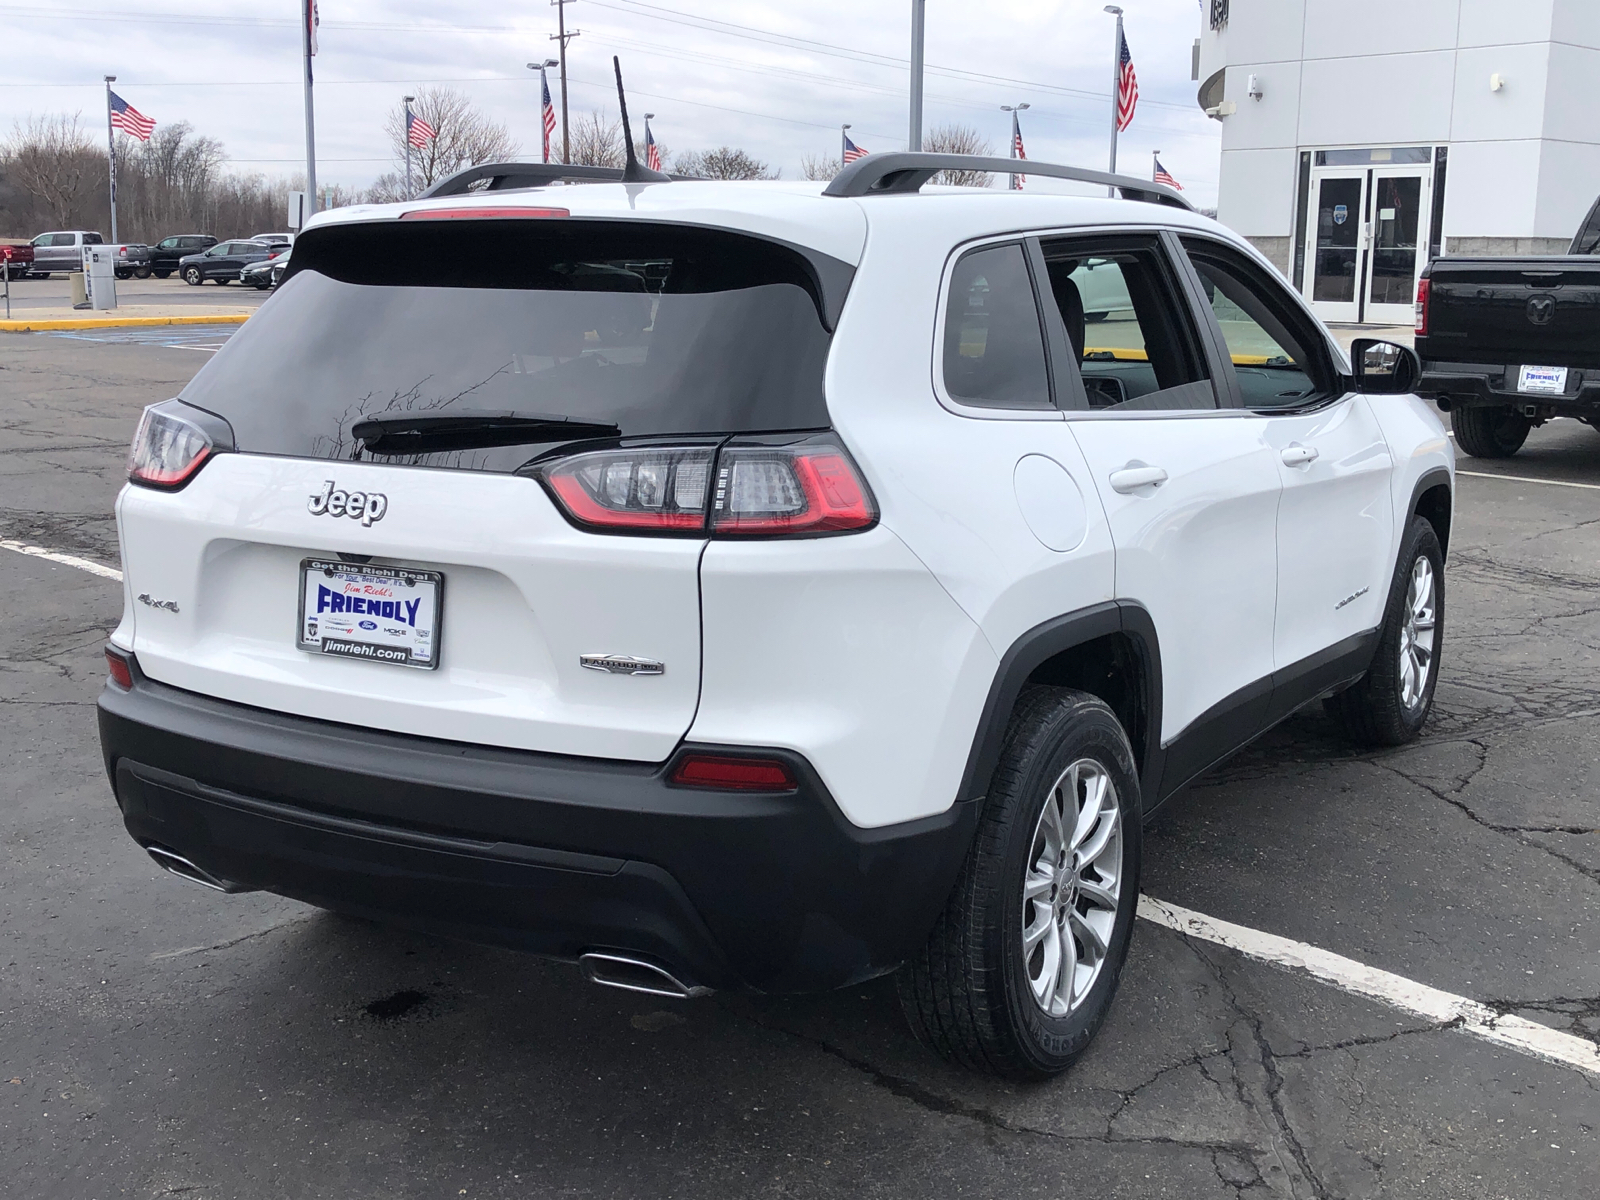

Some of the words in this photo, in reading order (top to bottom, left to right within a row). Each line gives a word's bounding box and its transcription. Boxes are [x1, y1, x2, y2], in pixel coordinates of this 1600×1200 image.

[1526, 372, 1560, 382] FRIENDLY
[307, 480, 388, 528] Jeep
[311, 561, 335, 570] Get
[338, 562, 358, 573] the
[362, 567, 395, 577] Riehl
[399, 571, 428, 580] Deal
[345, 574, 359, 582] Your
[343, 582, 361, 594] Jim
[363, 585, 393, 597] Riehl's
[317, 583, 421, 628] FRIENDLY
[360, 620, 376, 630] Ford
[324, 640, 406, 660] jimriehl.com
